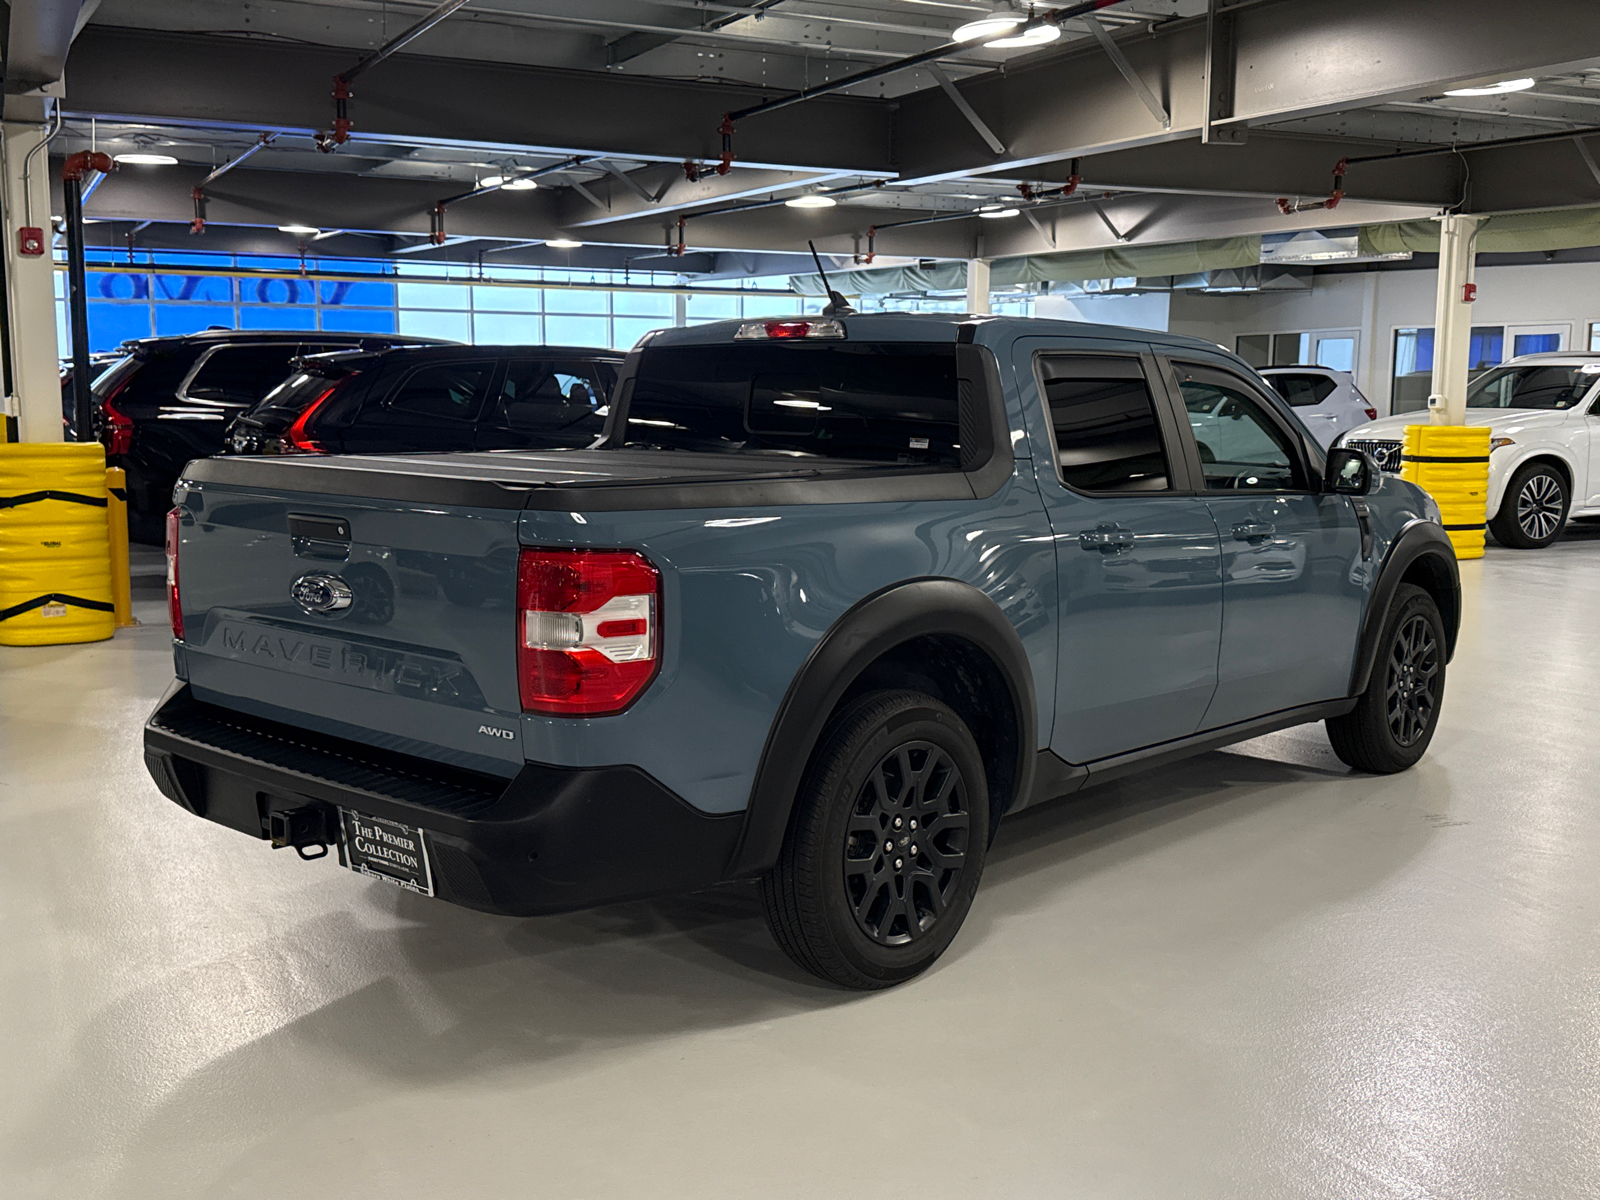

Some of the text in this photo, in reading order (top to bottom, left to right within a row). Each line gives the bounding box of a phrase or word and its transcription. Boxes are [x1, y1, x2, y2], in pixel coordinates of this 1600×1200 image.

[221, 627, 460, 696] MAVERICK
[478, 725, 515, 741] AWD
[352, 820, 375, 839] THE
[373, 825, 416, 852] PREMIER
[354, 836, 419, 869] COLLECTION
